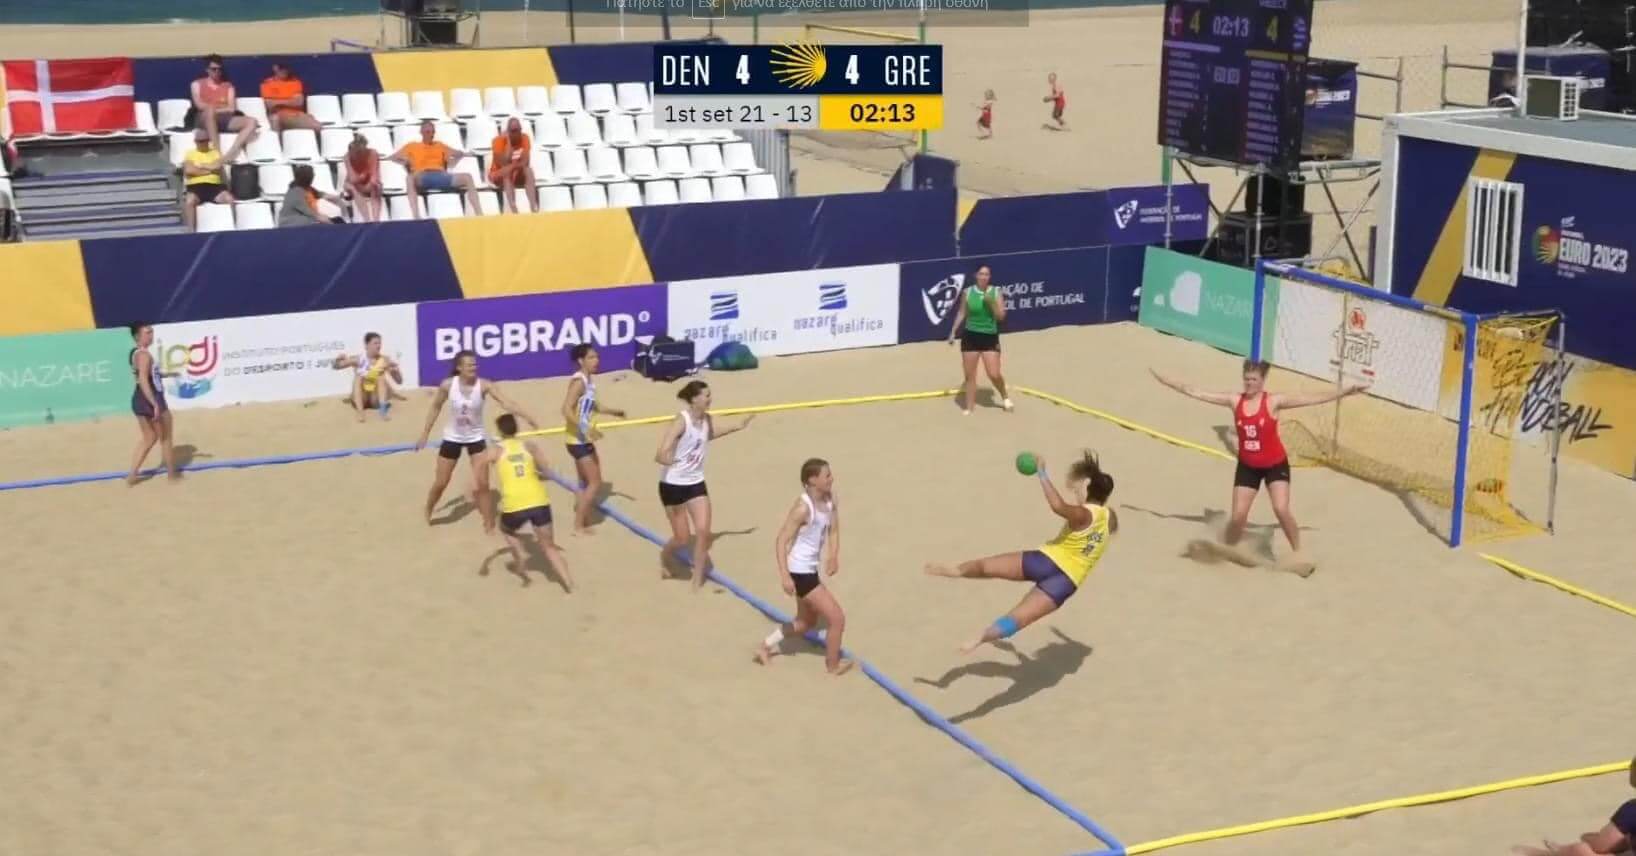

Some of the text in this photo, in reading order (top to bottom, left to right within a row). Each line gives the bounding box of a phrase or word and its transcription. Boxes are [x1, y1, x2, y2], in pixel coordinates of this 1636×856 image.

[1212, 15, 1249, 37] 02:13
[1559, 237, 1628, 273] EURO 2023
[1031, 281, 1045, 293] DE
[1019, 298, 1032, 309] DE
[1035, 292, 1085, 308] PORTUGAL
